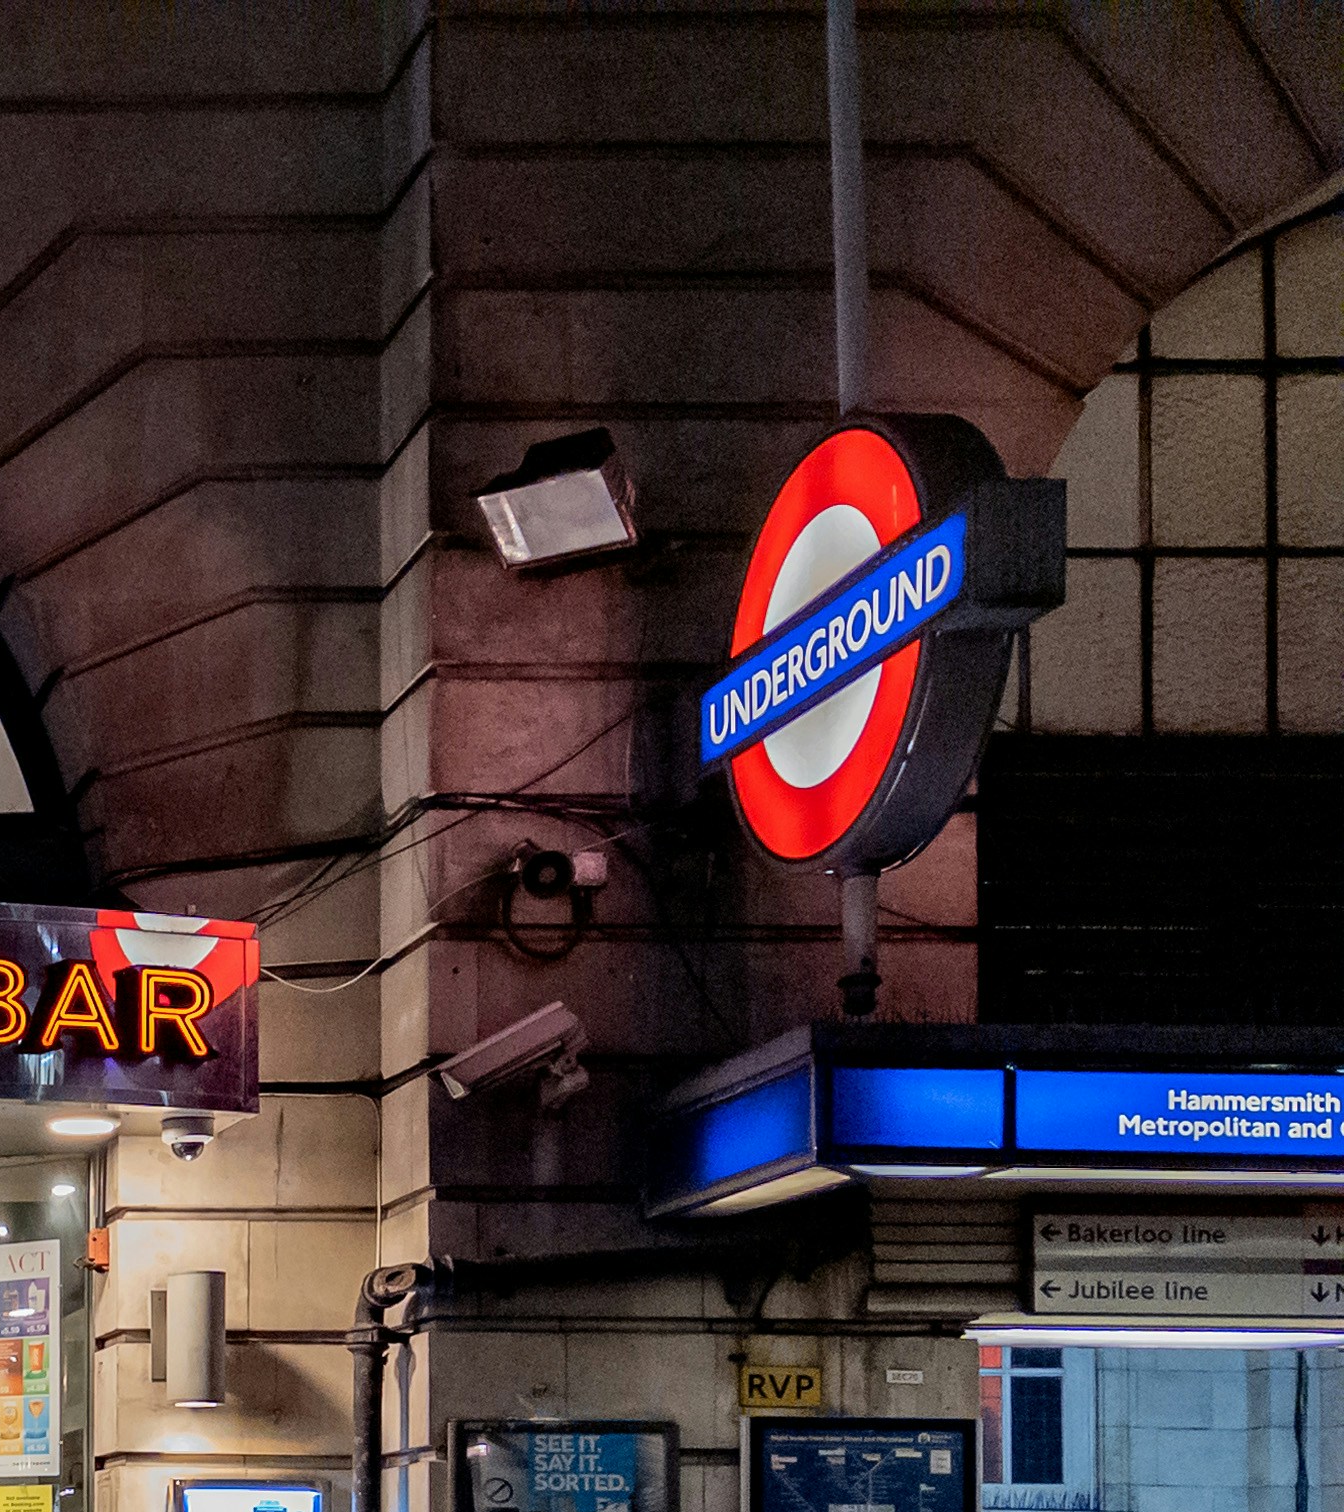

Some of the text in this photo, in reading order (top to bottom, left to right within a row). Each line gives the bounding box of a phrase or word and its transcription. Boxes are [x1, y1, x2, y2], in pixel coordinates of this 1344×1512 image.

[709, 544, 951, 744] UNDERGROUND
[1168, 1090, 1341, 1113] Hammersmith
[1119, 1115, 1332, 1141] Metropolitan and
[1068, 1224, 1226, 1244] Bakerloo line
[8, 1250, 51, 1274] ACT
[1068, 1280, 1208, 1301] Jubilee line
[748, 1374, 815, 1398] RVP
[534, 1435, 602, 1453] SEE IT.
[534, 1454, 603, 1471] SAY IT.
[534, 1474, 631, 1491] SORTED.
